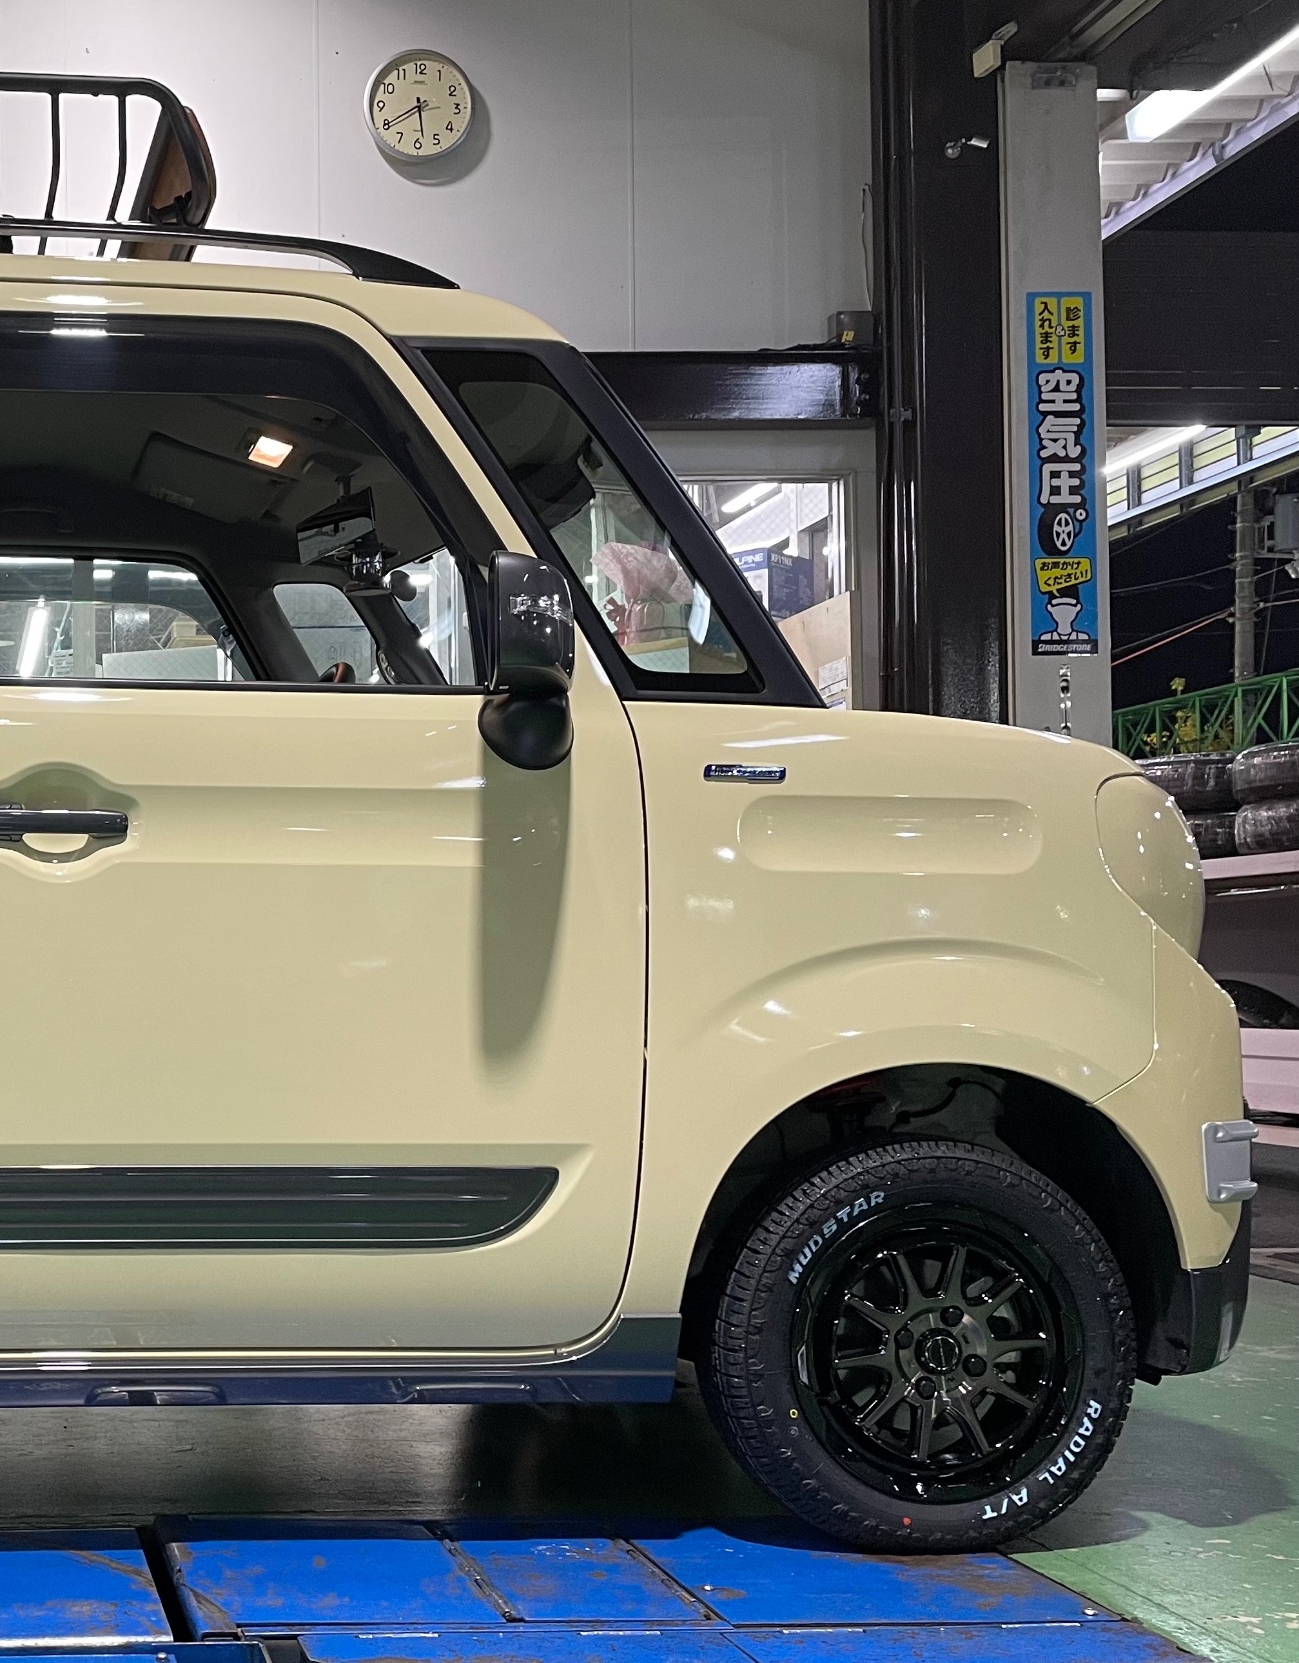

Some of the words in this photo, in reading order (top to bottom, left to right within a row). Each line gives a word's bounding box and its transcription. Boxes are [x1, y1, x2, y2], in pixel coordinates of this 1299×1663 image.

[396, 68, 406, 80] 11
[413, 62, 427, 75] 12
[437, 69, 442, 81] 1
[381, 82, 395, 95] 10
[448, 85, 457, 97] 2
[376, 100, 386, 112] 9
[453, 103, 461, 115] 3
[382, 118, 390, 131] 8
[445, 120, 454, 133] 4
[396, 131, 404, 144] 7
[413, 137, 422, 150] 6
[432, 133, 441, 146] 5
[1038, 301, 1055, 361] 入れます
[1065, 306, 1082, 355] 診ます
[1038, 369, 1082, 504] 空気圧
[1039, 561, 1082, 571] お声かけ
[1037, 643, 1092, 652] BRIDGESTONE
[787, 1190, 885, 1285] MUDSTAR
[1038, 1399, 1103, 1485] RADIAL
[981, 1486, 1029, 1520] A/T
